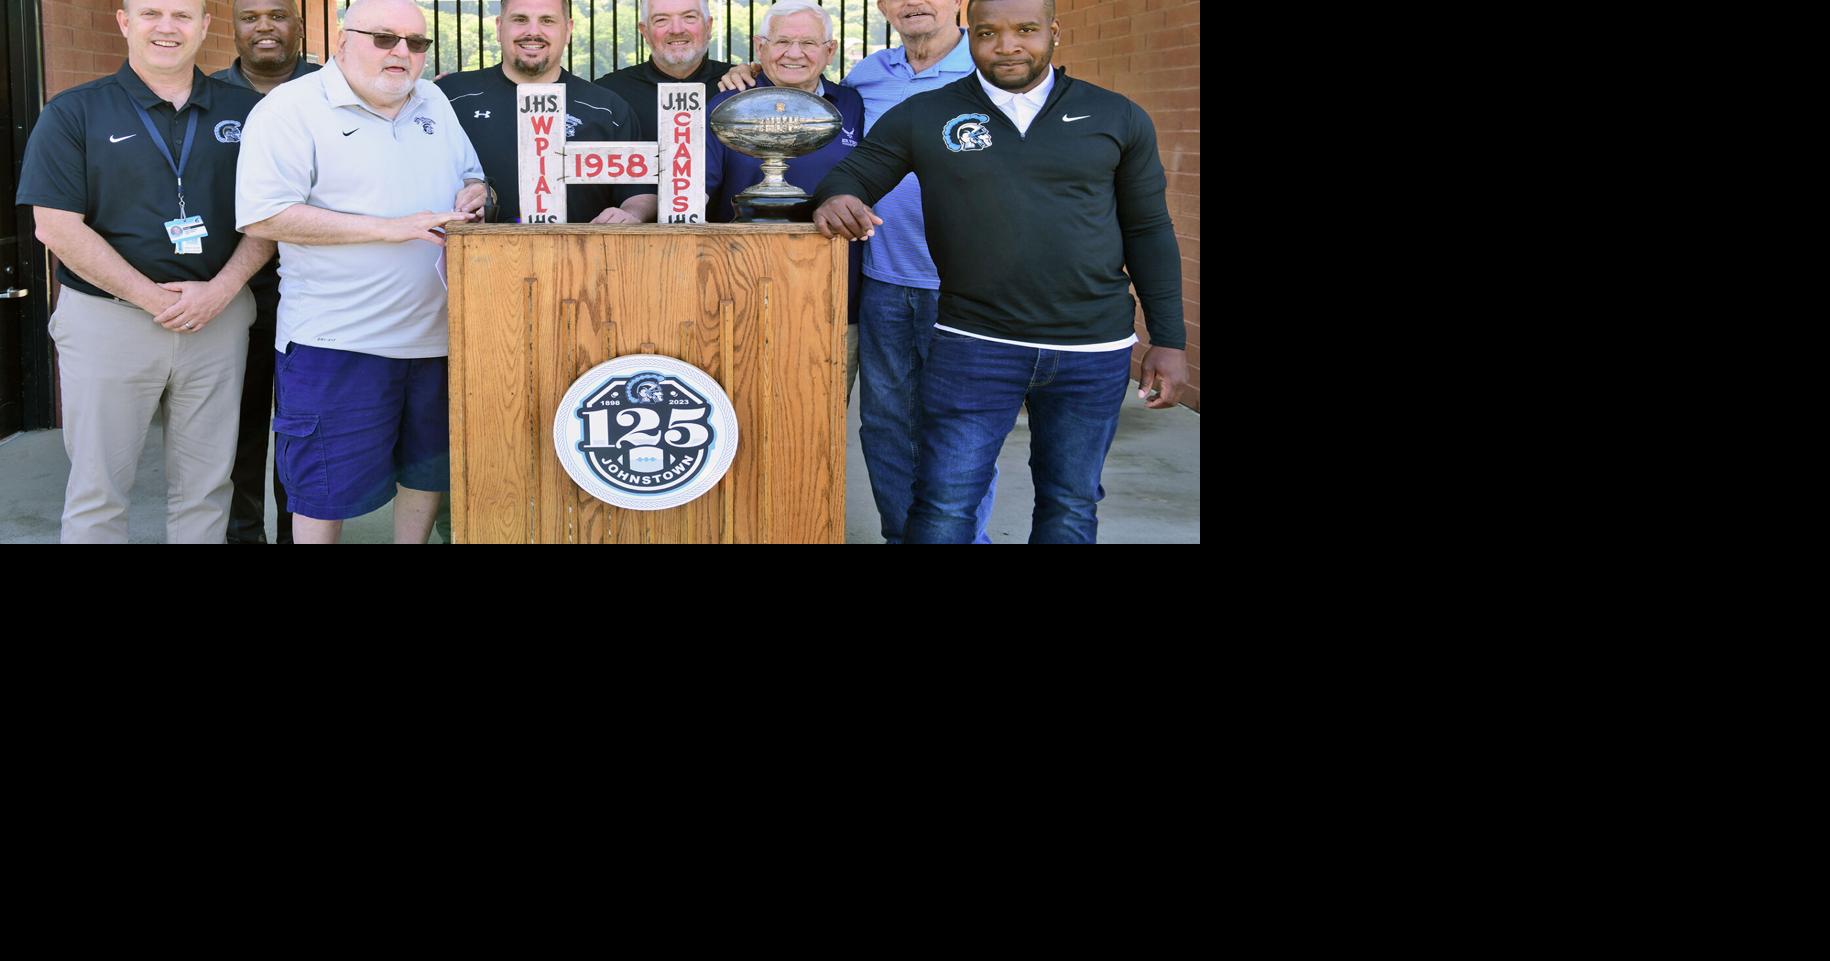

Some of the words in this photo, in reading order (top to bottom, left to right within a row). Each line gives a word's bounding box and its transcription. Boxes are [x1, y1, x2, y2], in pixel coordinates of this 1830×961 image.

[520, 94, 560, 113] J.H.S.
[662, 91, 702, 111] J.H.S.
[531, 115, 554, 213] WPIAL
[575, 153, 648, 178] 1958
[671, 112, 692, 212] CHAMPS
[582, 407, 709, 449] 125
[601, 455, 694, 485] JOHNSTOWN
